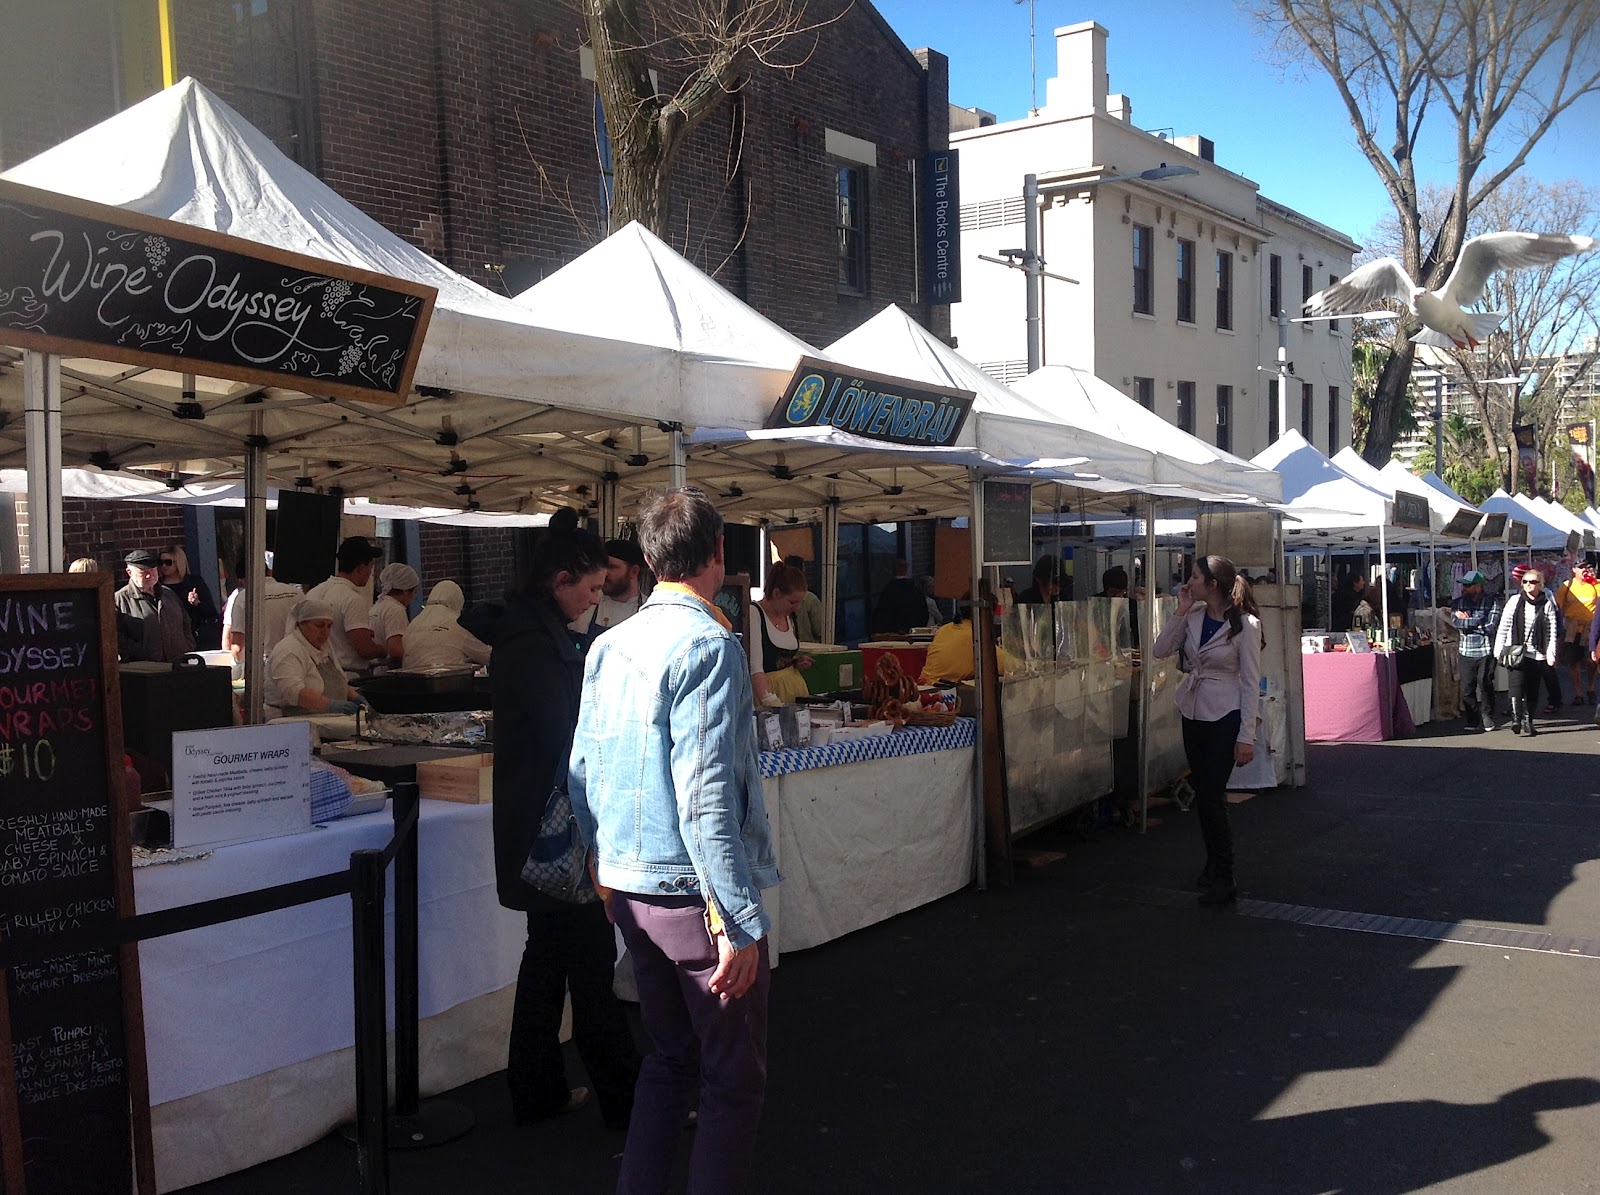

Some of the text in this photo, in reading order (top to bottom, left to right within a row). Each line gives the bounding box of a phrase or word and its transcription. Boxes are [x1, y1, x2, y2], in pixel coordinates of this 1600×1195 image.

[936, 174, 949, 279] The Rocks Centre
[31, 231, 344, 364] Wine Odyssey
[0, 643, 88, 674] DYSSEY
[0, 678, 97, 710] OURMET
[0, 738, 56, 781] $10
[213, 748, 290, 765] GOURMET WRAPS
[0, 813, 48, 831] RESHLY
[15, 819, 95, 843] MEATBALLS
[4, 839, 58, 857] CHEESE
[38, 845, 97, 867] SPINACH
[99, 844, 108, 857] &
[1, 859, 100, 886] OMATO SAUCE
[66, 896, 116, 918] CHICKEN
[87, 954, 112, 967] MINT
[17, 966, 120, 995] YOGHURT DRESSING
[12, 1036, 42, 1056] OAST
[13, 1053, 34, 1067] ETA
[40, 1039, 90, 1060] CHEESE
[15, 1065, 38, 1081] ABY
[44, 1049, 96, 1073] SPINACH
[18, 1072, 69, 1094] ALNUTS
[91, 1058, 124, 1074] PESTO
[24, 1072, 122, 1105] SAUCE DRESSING
